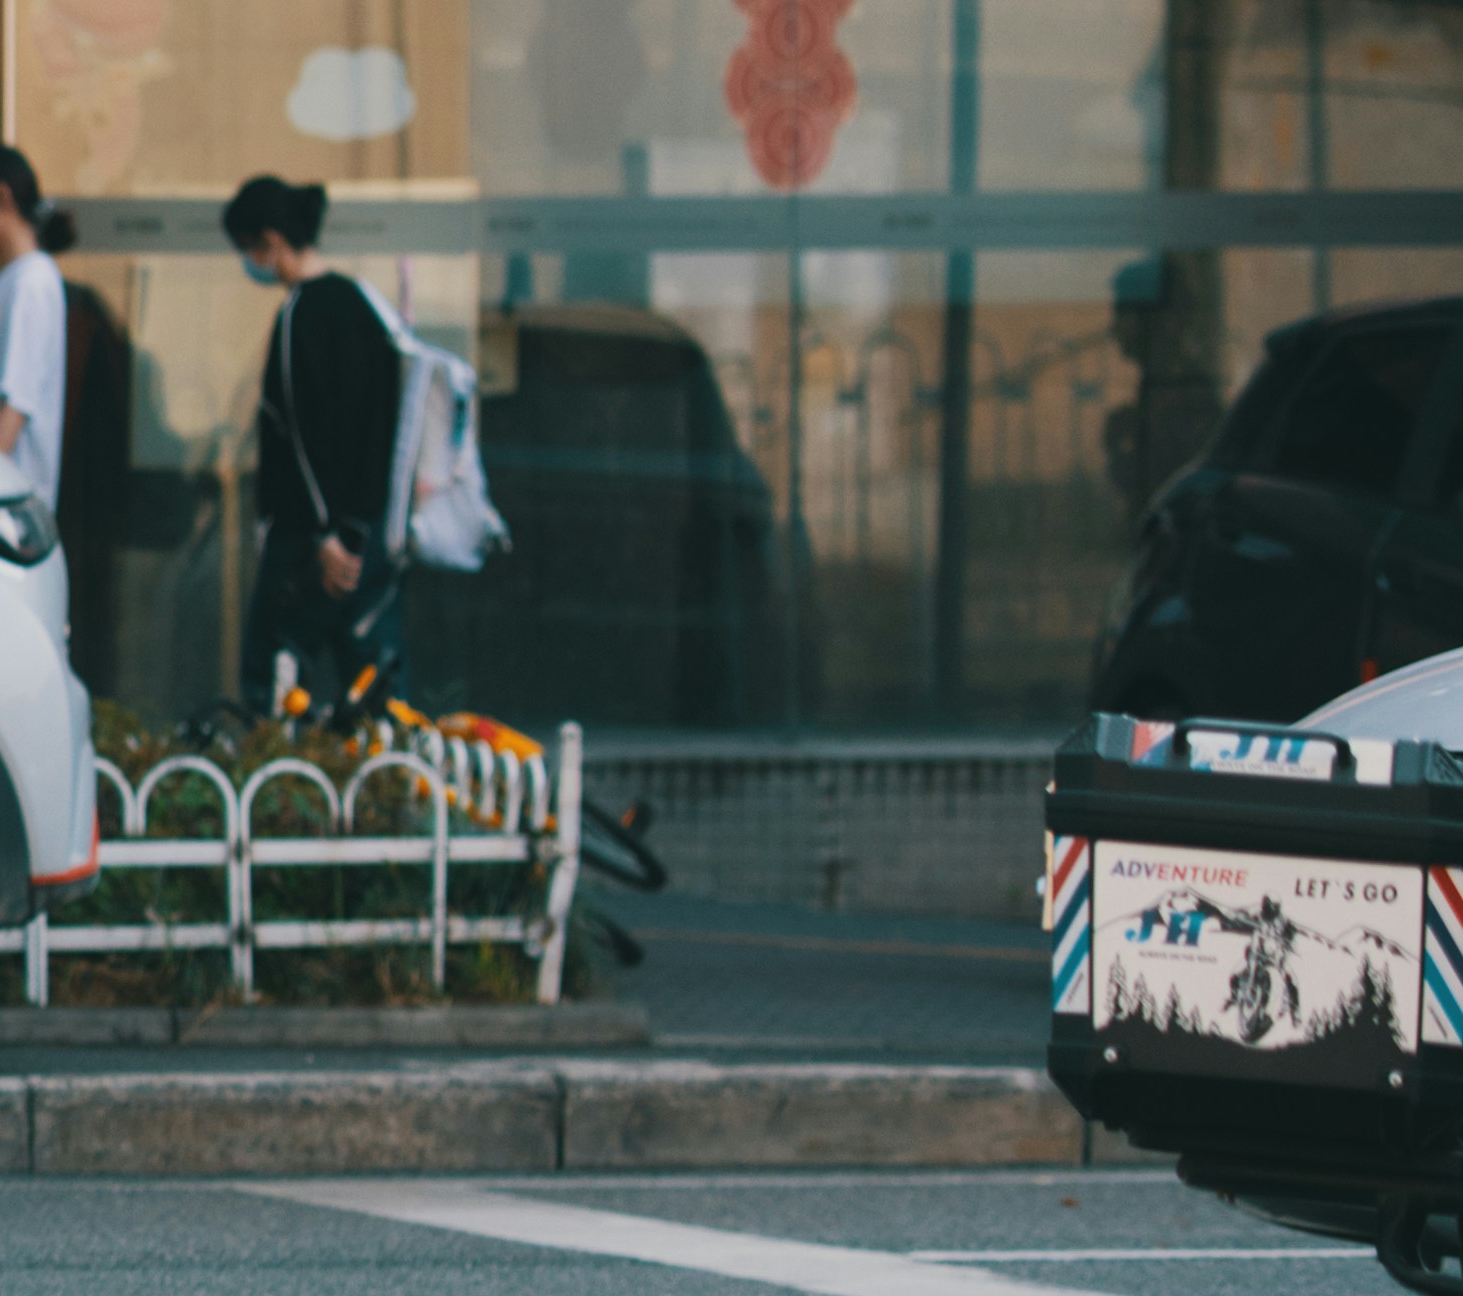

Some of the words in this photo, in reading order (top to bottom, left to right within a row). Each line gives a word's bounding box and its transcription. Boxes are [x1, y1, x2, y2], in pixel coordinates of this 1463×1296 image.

[1111, 860, 1249, 887] ADVENTURE
[1363, 883, 1399, 904] GO
[1125, 910, 1205, 946] JH
